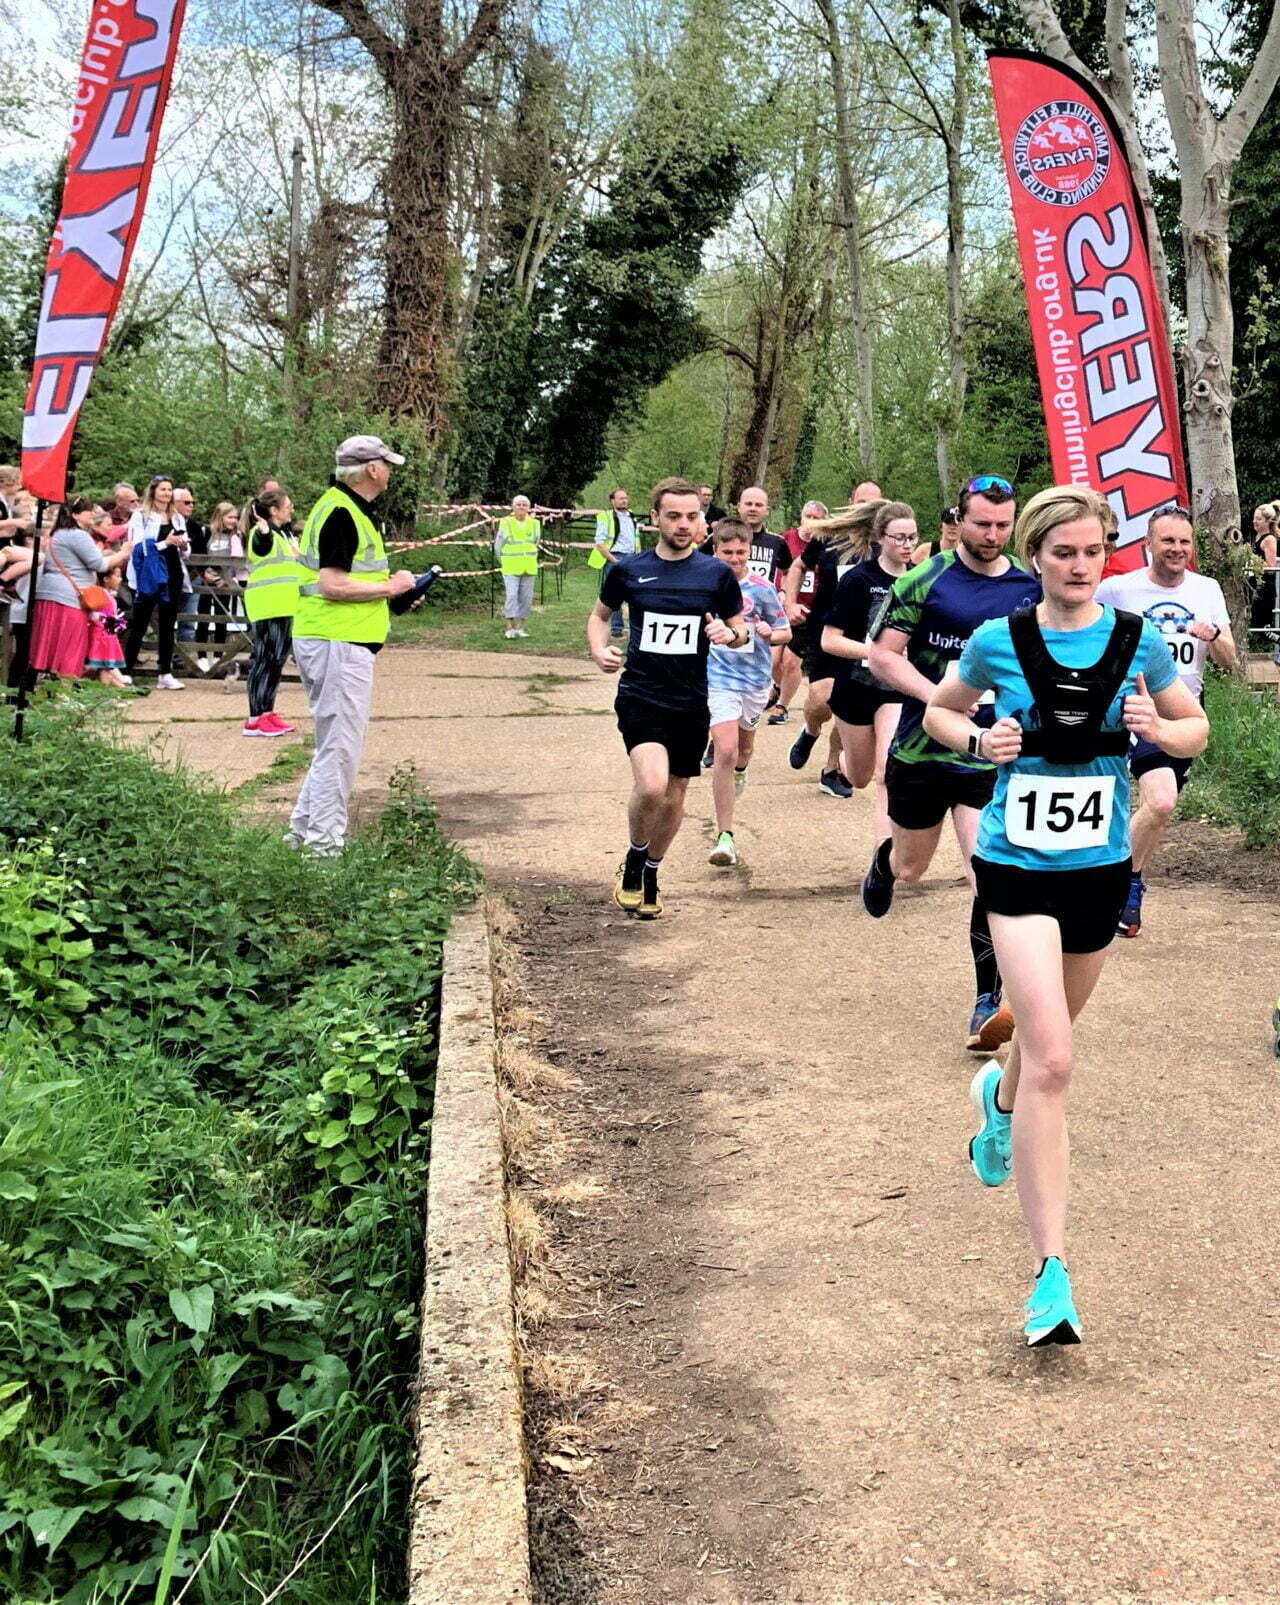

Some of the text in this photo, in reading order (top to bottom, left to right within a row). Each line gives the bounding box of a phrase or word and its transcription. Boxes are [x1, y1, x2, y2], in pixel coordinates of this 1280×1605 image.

[748, 544, 774, 562] BANS
[648, 621, 692, 645] 171
[1017, 790, 1105, 833] 154
